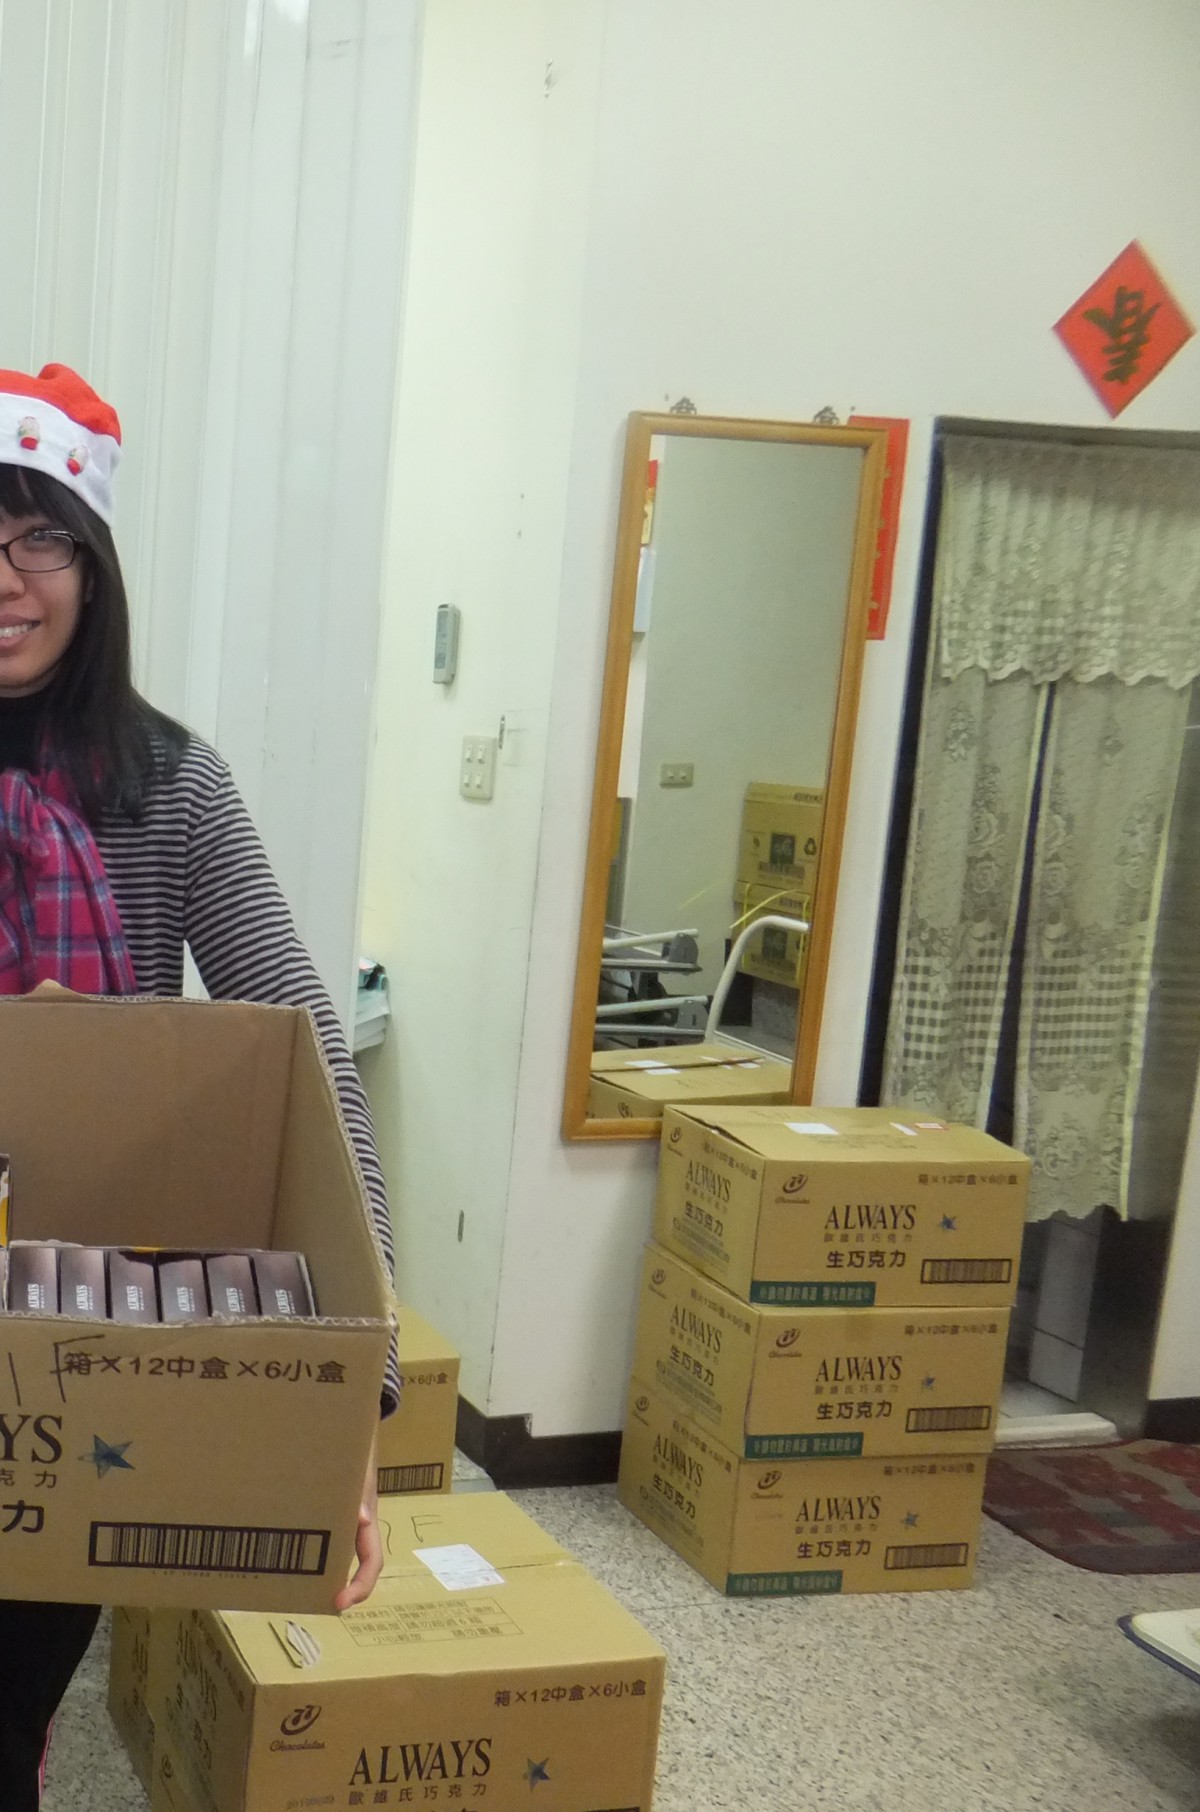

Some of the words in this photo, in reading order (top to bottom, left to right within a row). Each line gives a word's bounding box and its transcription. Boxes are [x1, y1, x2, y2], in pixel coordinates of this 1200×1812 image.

[686, 1160, 731, 1203] ALWAYS
[824, 1204, 916, 1230] ALWAYS
[826, 1250, 907, 1269] 生巧克力
[670, 1304, 722, 1354] ALWAYS
[815, 1355, 902, 1382] ALWAYS
[816, 1400, 892, 1420] 生巧克力
[655, 1434, 704, 1487] ALWAYS
[795, 1495, 882, 1522] ALWAYS
[797, 1539, 872, 1560] 生巧克力
[348, 1738, 492, 1785] ALWAYS
